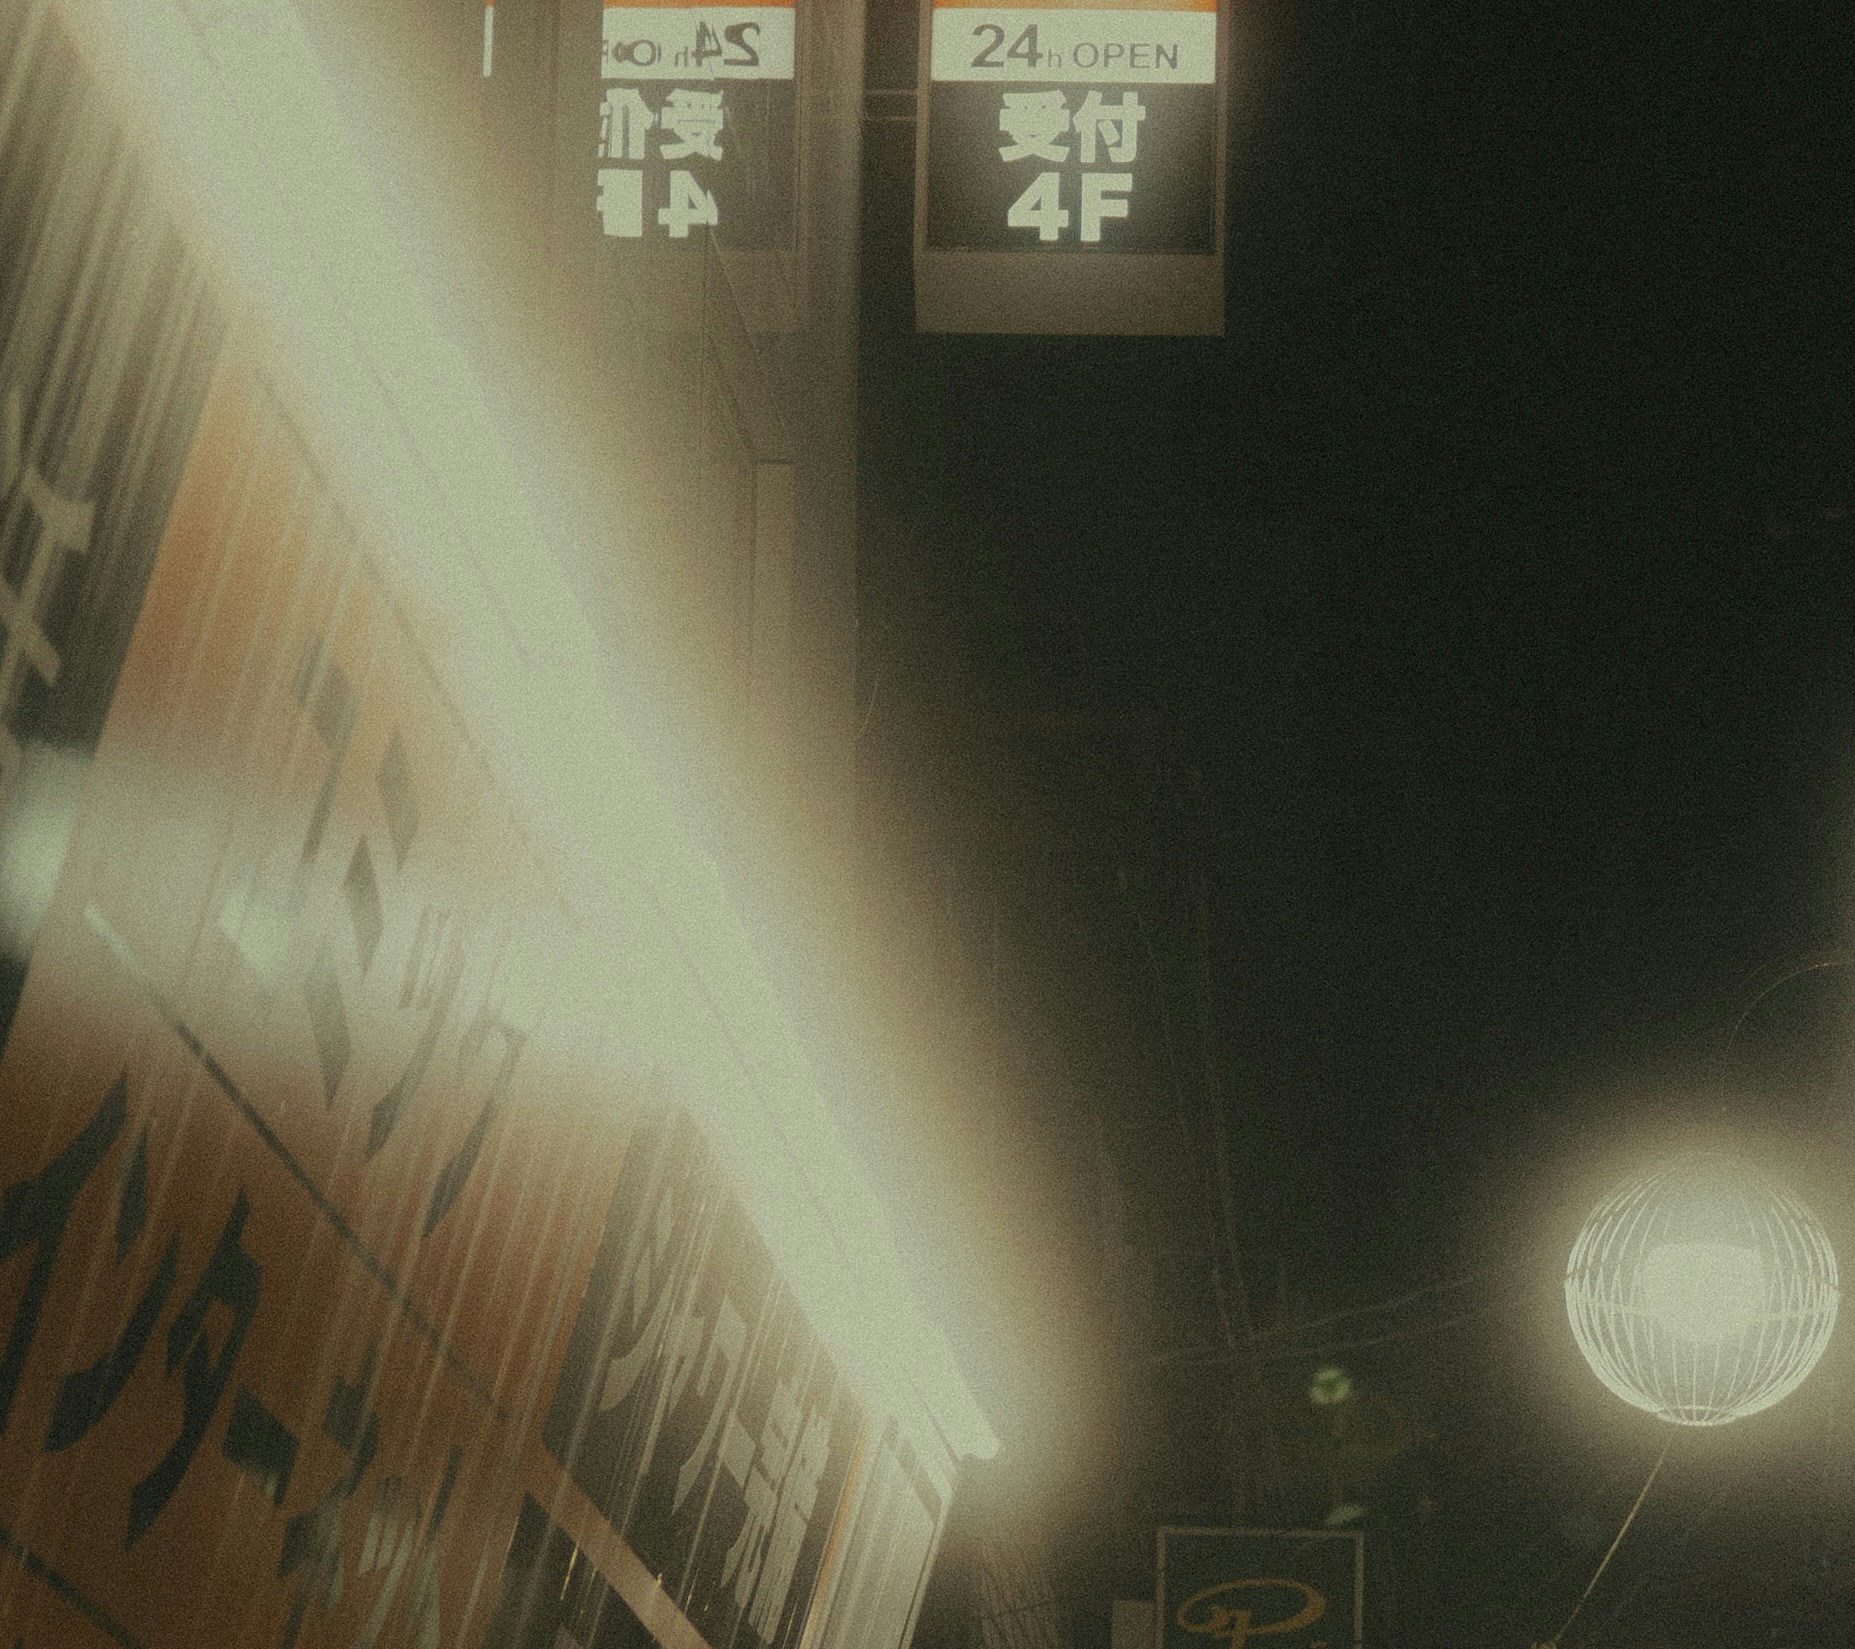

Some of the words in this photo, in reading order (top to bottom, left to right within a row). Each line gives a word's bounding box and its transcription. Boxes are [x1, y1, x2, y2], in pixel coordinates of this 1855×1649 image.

[1073, 42, 1180, 70] OPEN
[999, 91, 1146, 163] 受付
[1007, 172, 1134, 242] 4F
